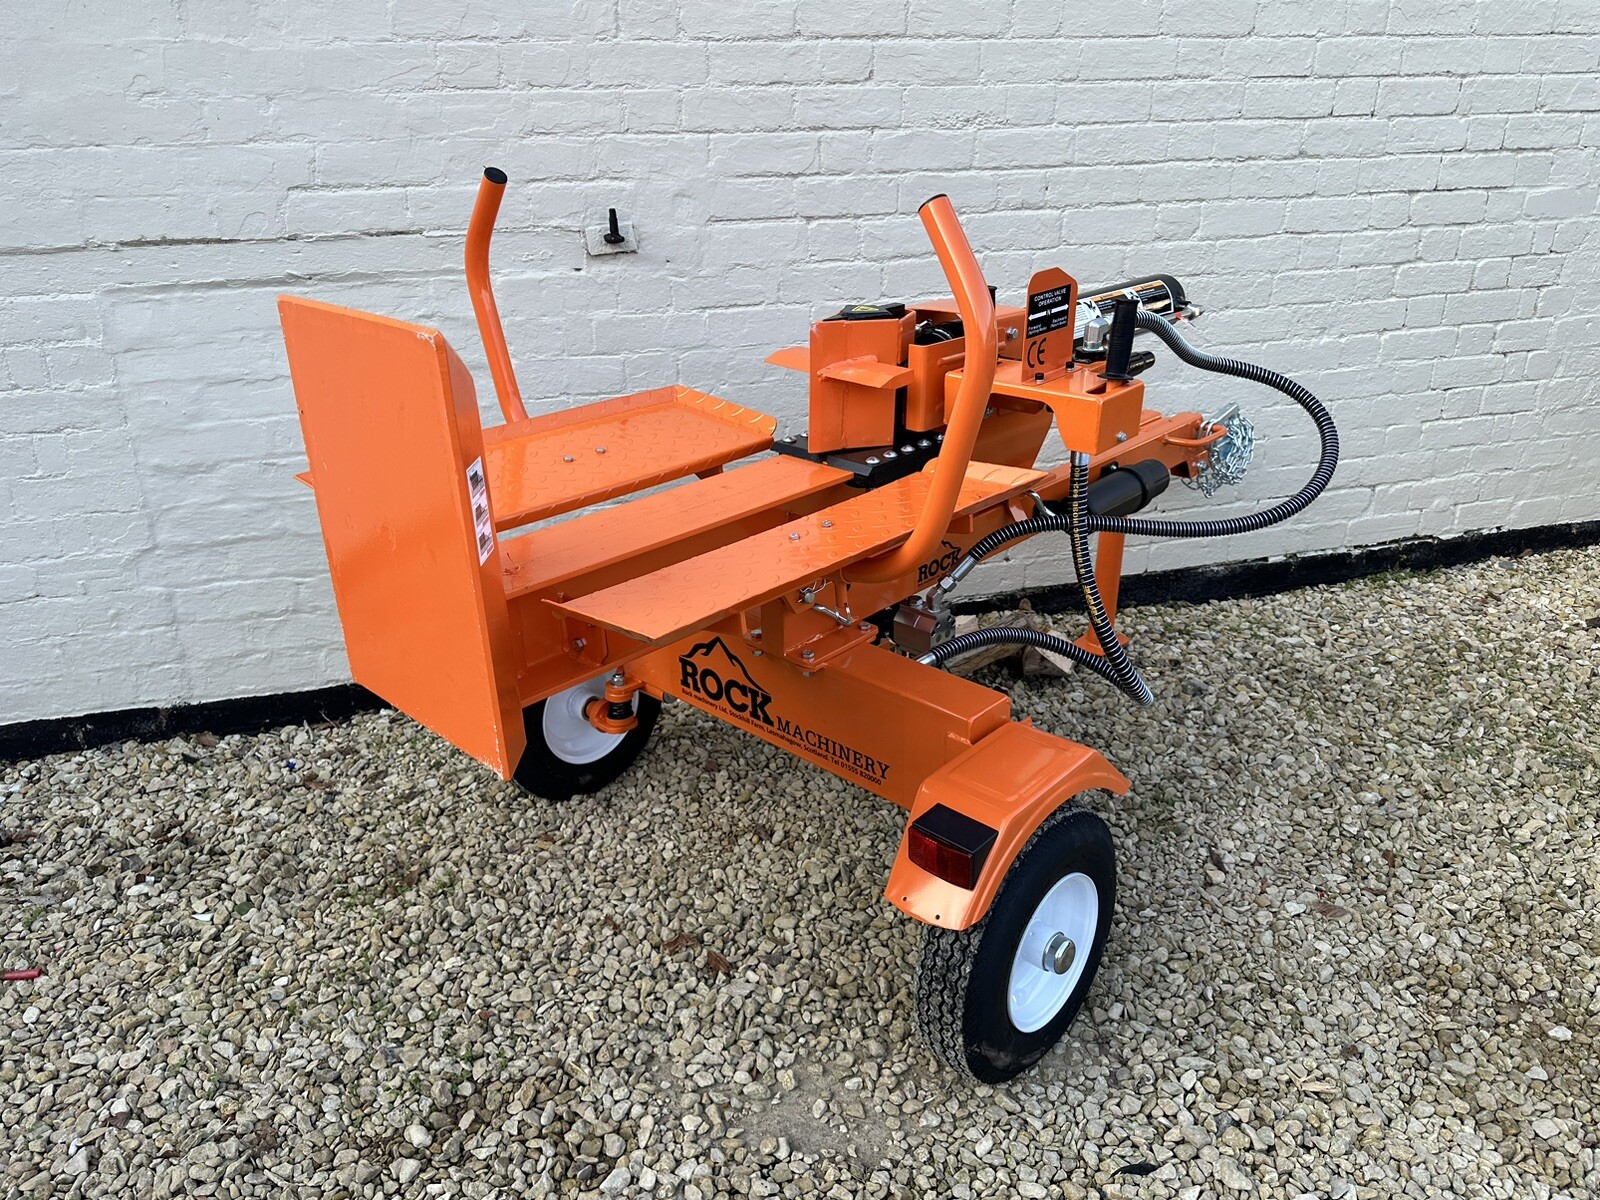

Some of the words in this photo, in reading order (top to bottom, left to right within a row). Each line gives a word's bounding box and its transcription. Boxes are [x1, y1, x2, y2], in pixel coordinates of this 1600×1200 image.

[1034, 291, 1053, 302] CONTROL
[1053, 287, 1067, 295] VALVE
[1038, 296, 1062, 307] OPERATION
[917, 549, 961, 583] ROCK
[679, 656, 775, 727] ROCK
[681, 687, 693, 698] Rock
[693, 693, 718, 711] machinery
[831, 756, 840, 766] Tel
[840, 761, 859, 776] 01555
[859, 769, 882, 786] 820000
[776, 715, 890, 780] MACHINERY
